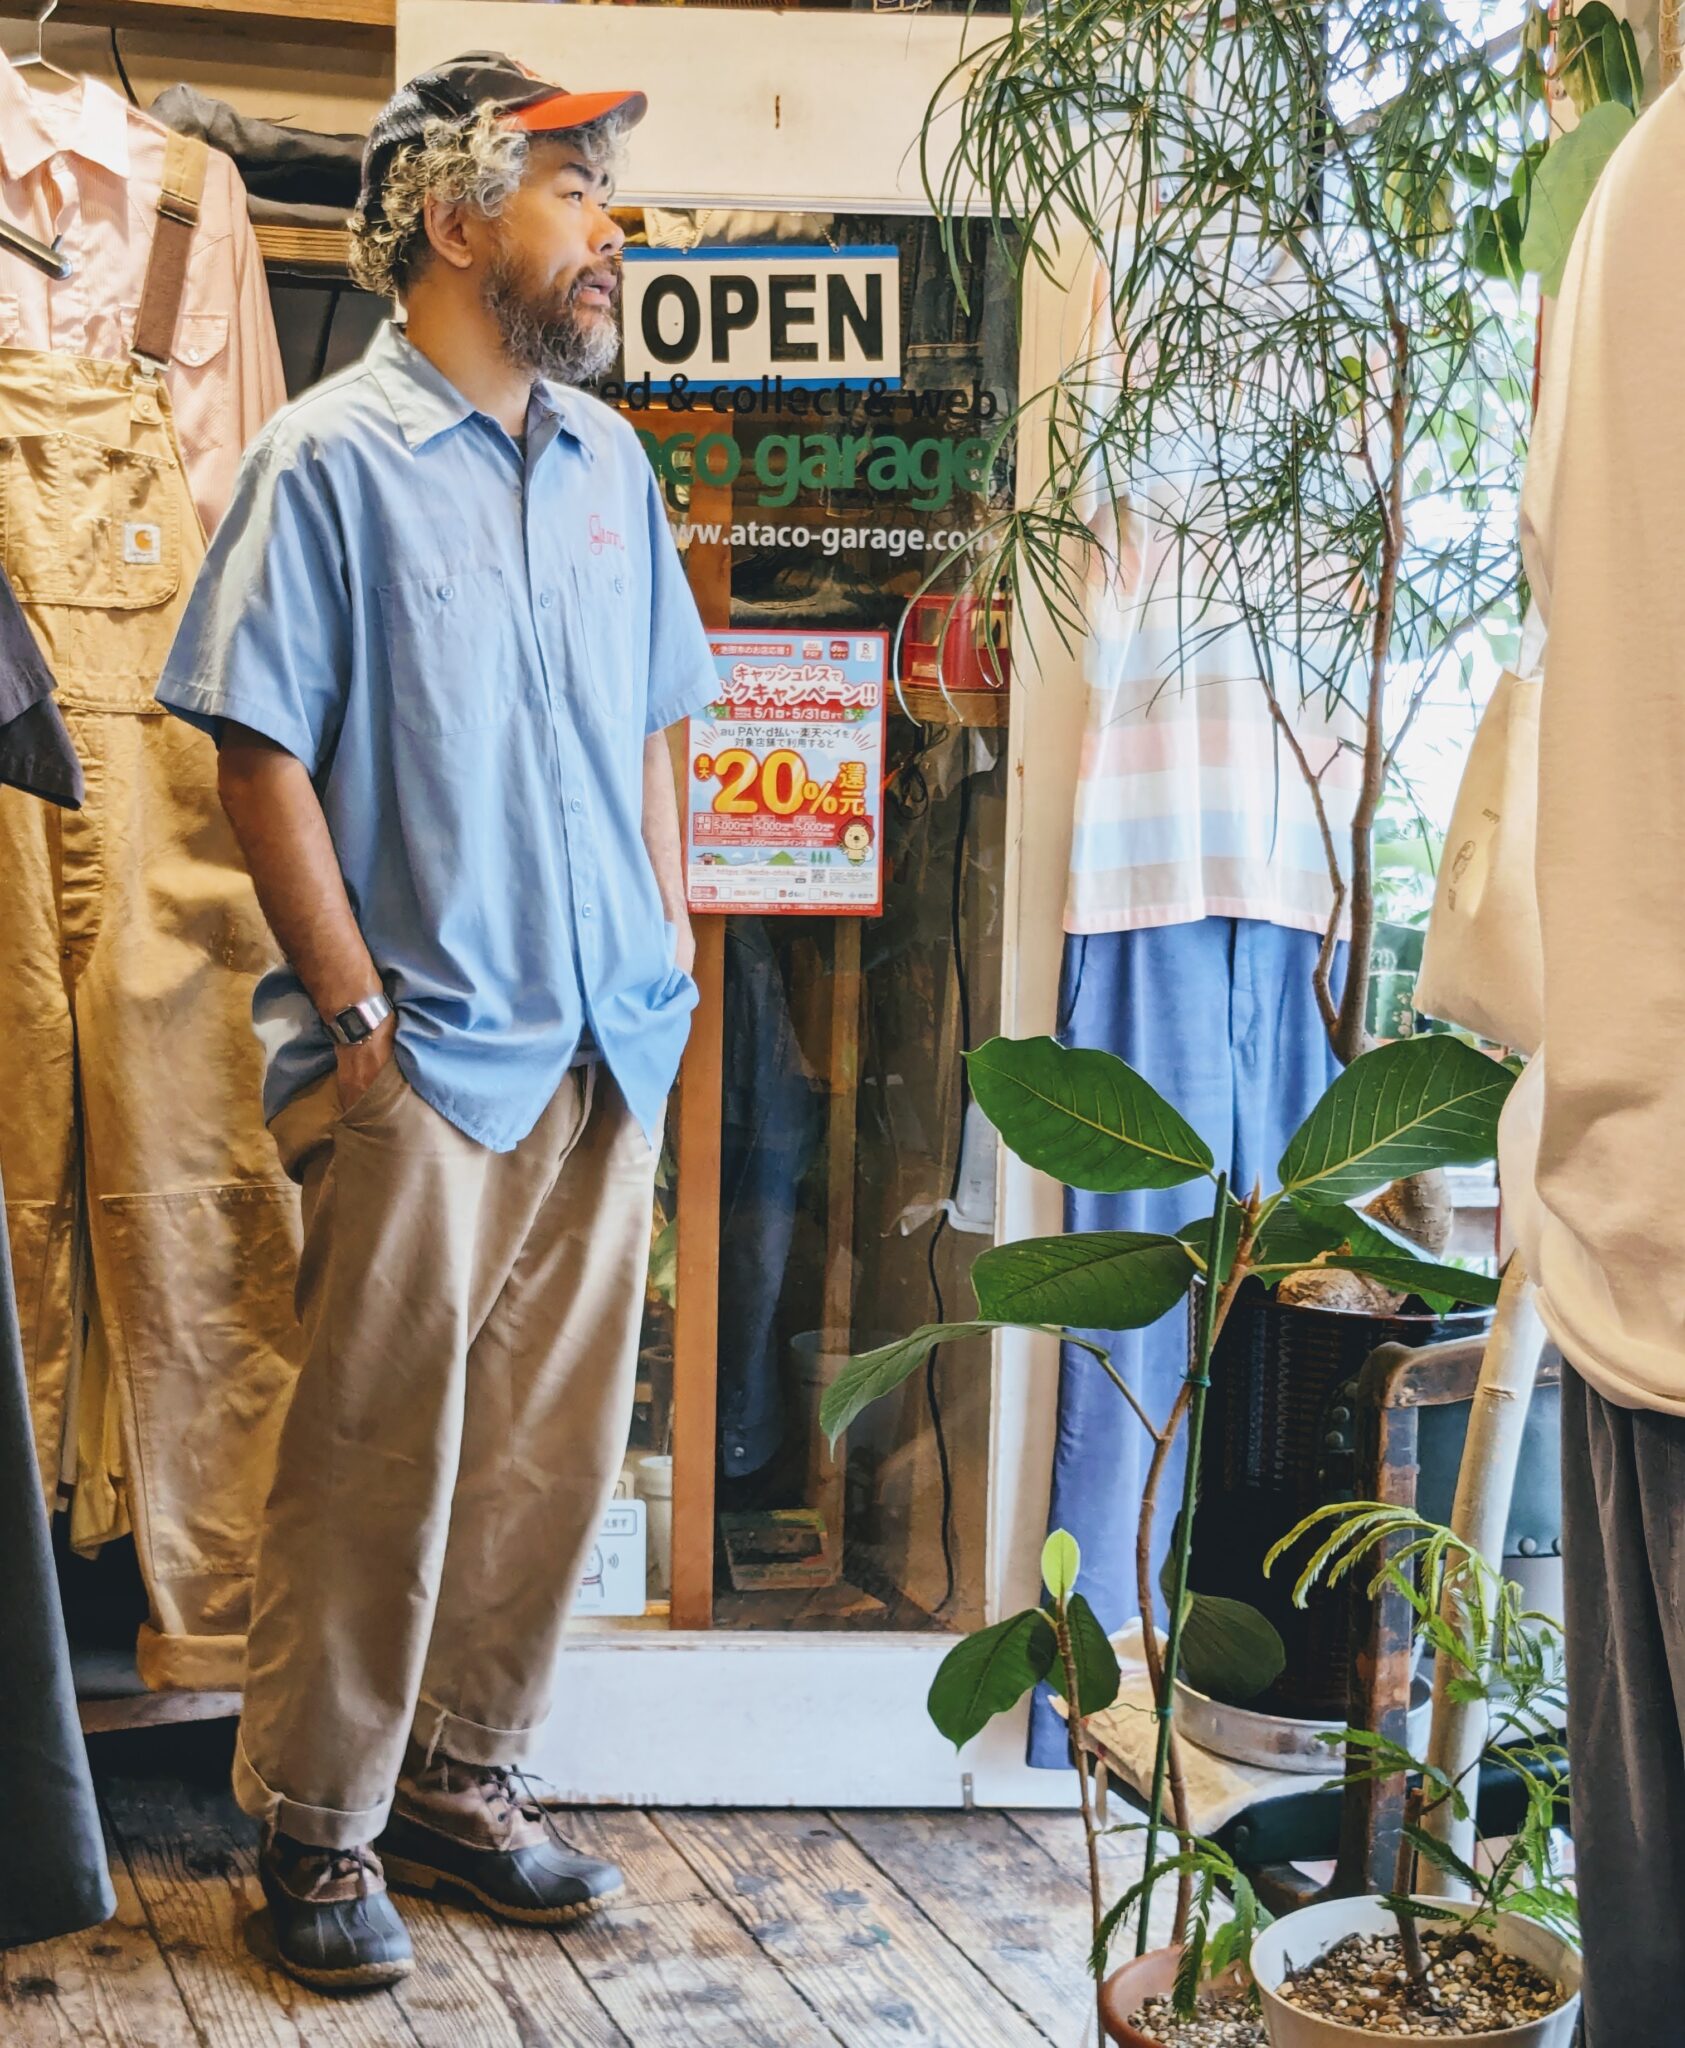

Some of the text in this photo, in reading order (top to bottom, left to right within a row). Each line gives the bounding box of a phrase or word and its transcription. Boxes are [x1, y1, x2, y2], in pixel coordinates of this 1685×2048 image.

[641, 273, 884, 364] OPEN
[666, 373, 697, 412] &
[709, 375, 856, 417] collect
[864, 378, 892, 417] &
[909, 379, 998, 420] web
[754, 432, 991, 511] garage
[735, 666, 841, 682] キャッシュレスで
[735, 738, 834, 749] 対象店舗で利用すると
[714, 749, 838, 815] 20%
[839, 761, 866, 816] 還元
